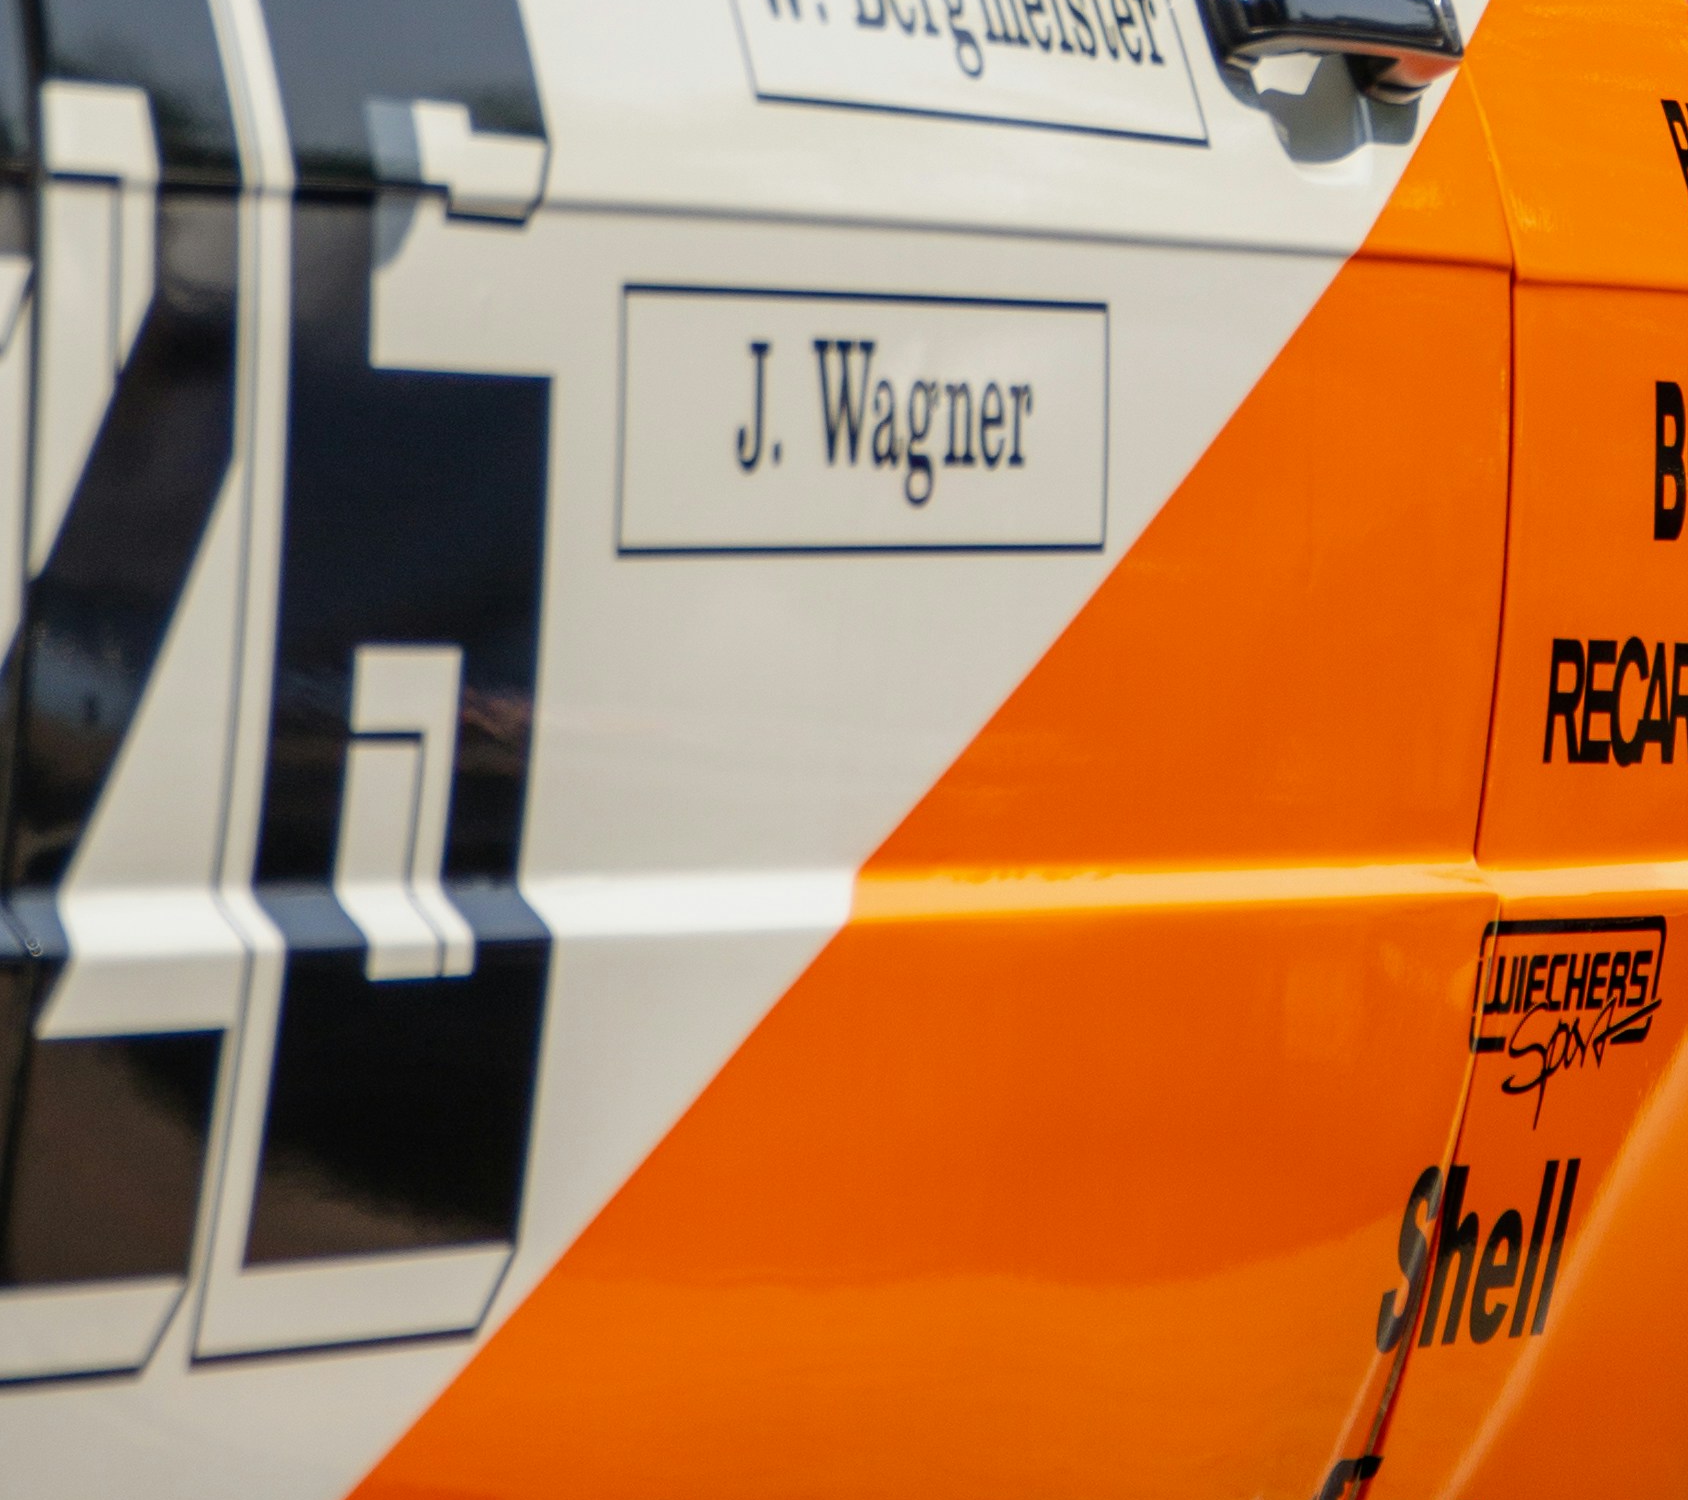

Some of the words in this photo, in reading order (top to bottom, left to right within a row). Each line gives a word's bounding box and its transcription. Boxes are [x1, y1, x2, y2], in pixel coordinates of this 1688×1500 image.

[736, 340, 782, 475] J.
[811, 338, 1034, 508] Wagner
[1482, 950, 1655, 1015] WIECHERS
[1501, 996, 1663, 1131] Sport
[1375, 1157, 1582, 1355] Shell
